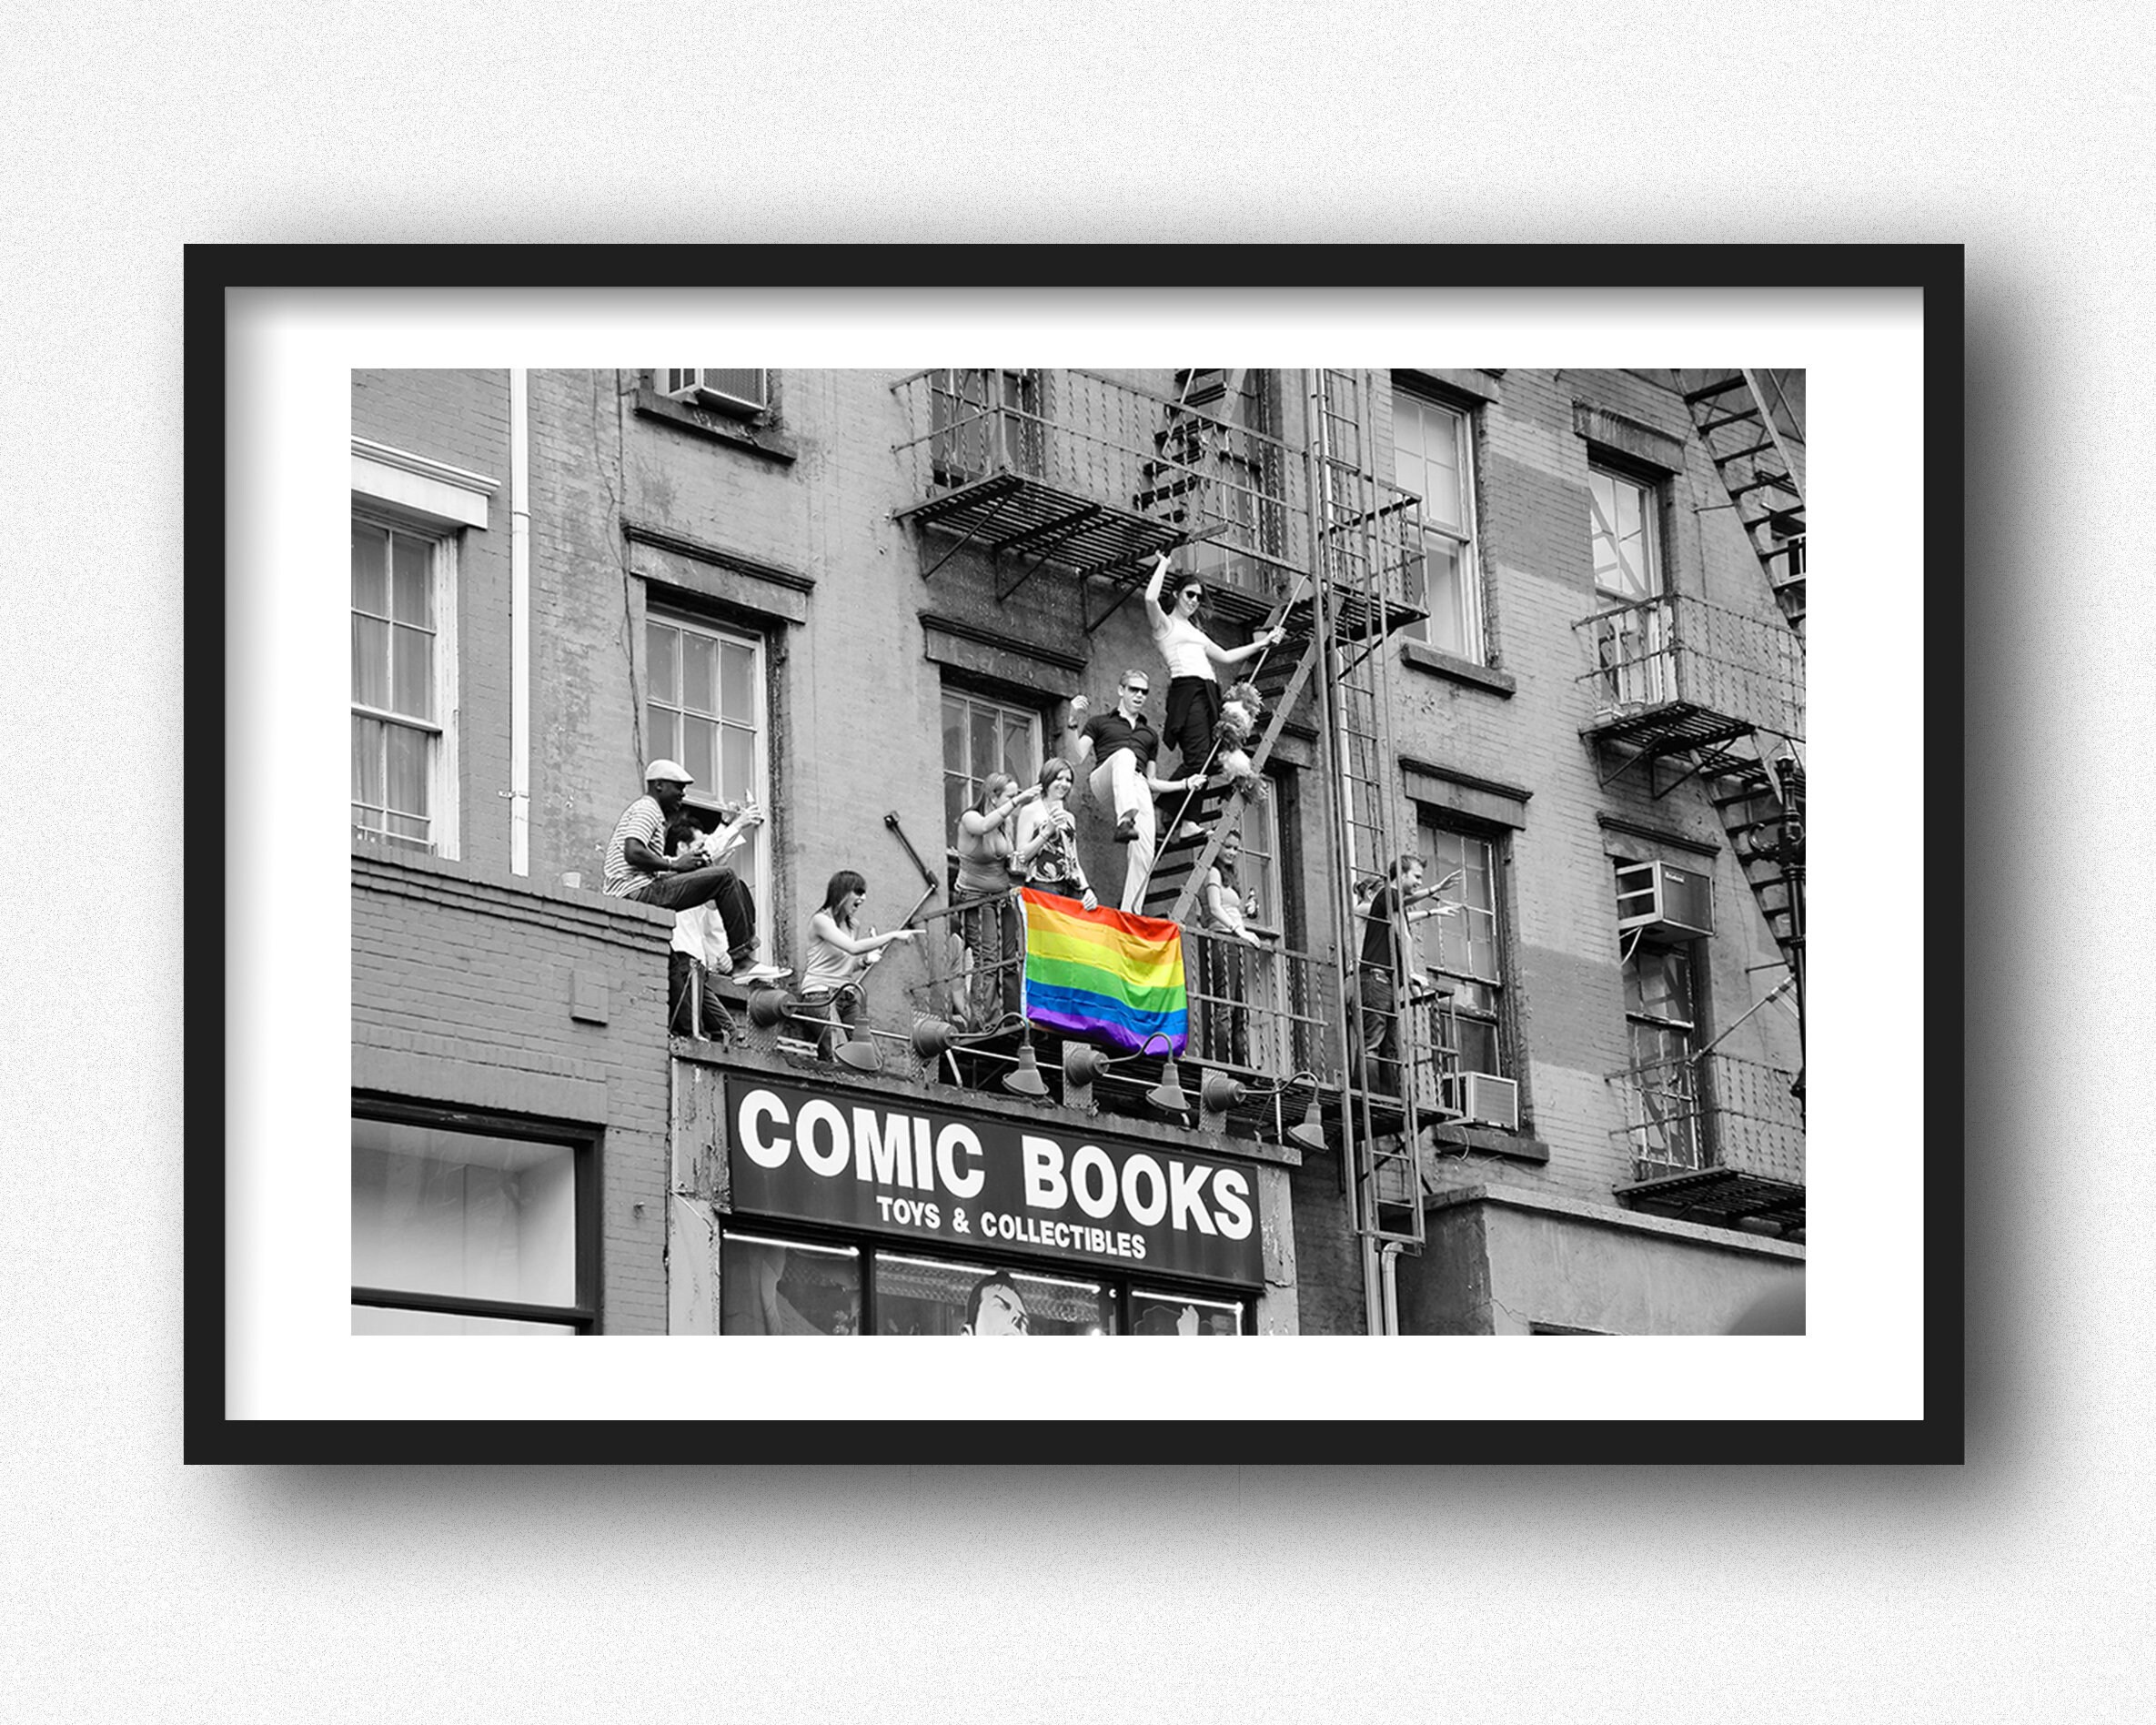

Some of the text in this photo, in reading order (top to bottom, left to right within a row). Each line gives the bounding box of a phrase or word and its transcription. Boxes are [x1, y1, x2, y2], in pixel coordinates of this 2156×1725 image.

[738, 1089, 1254, 1240] COMIC BOOKS
[876, 1195, 1147, 1260] TOYS & COLLECTIBLES
